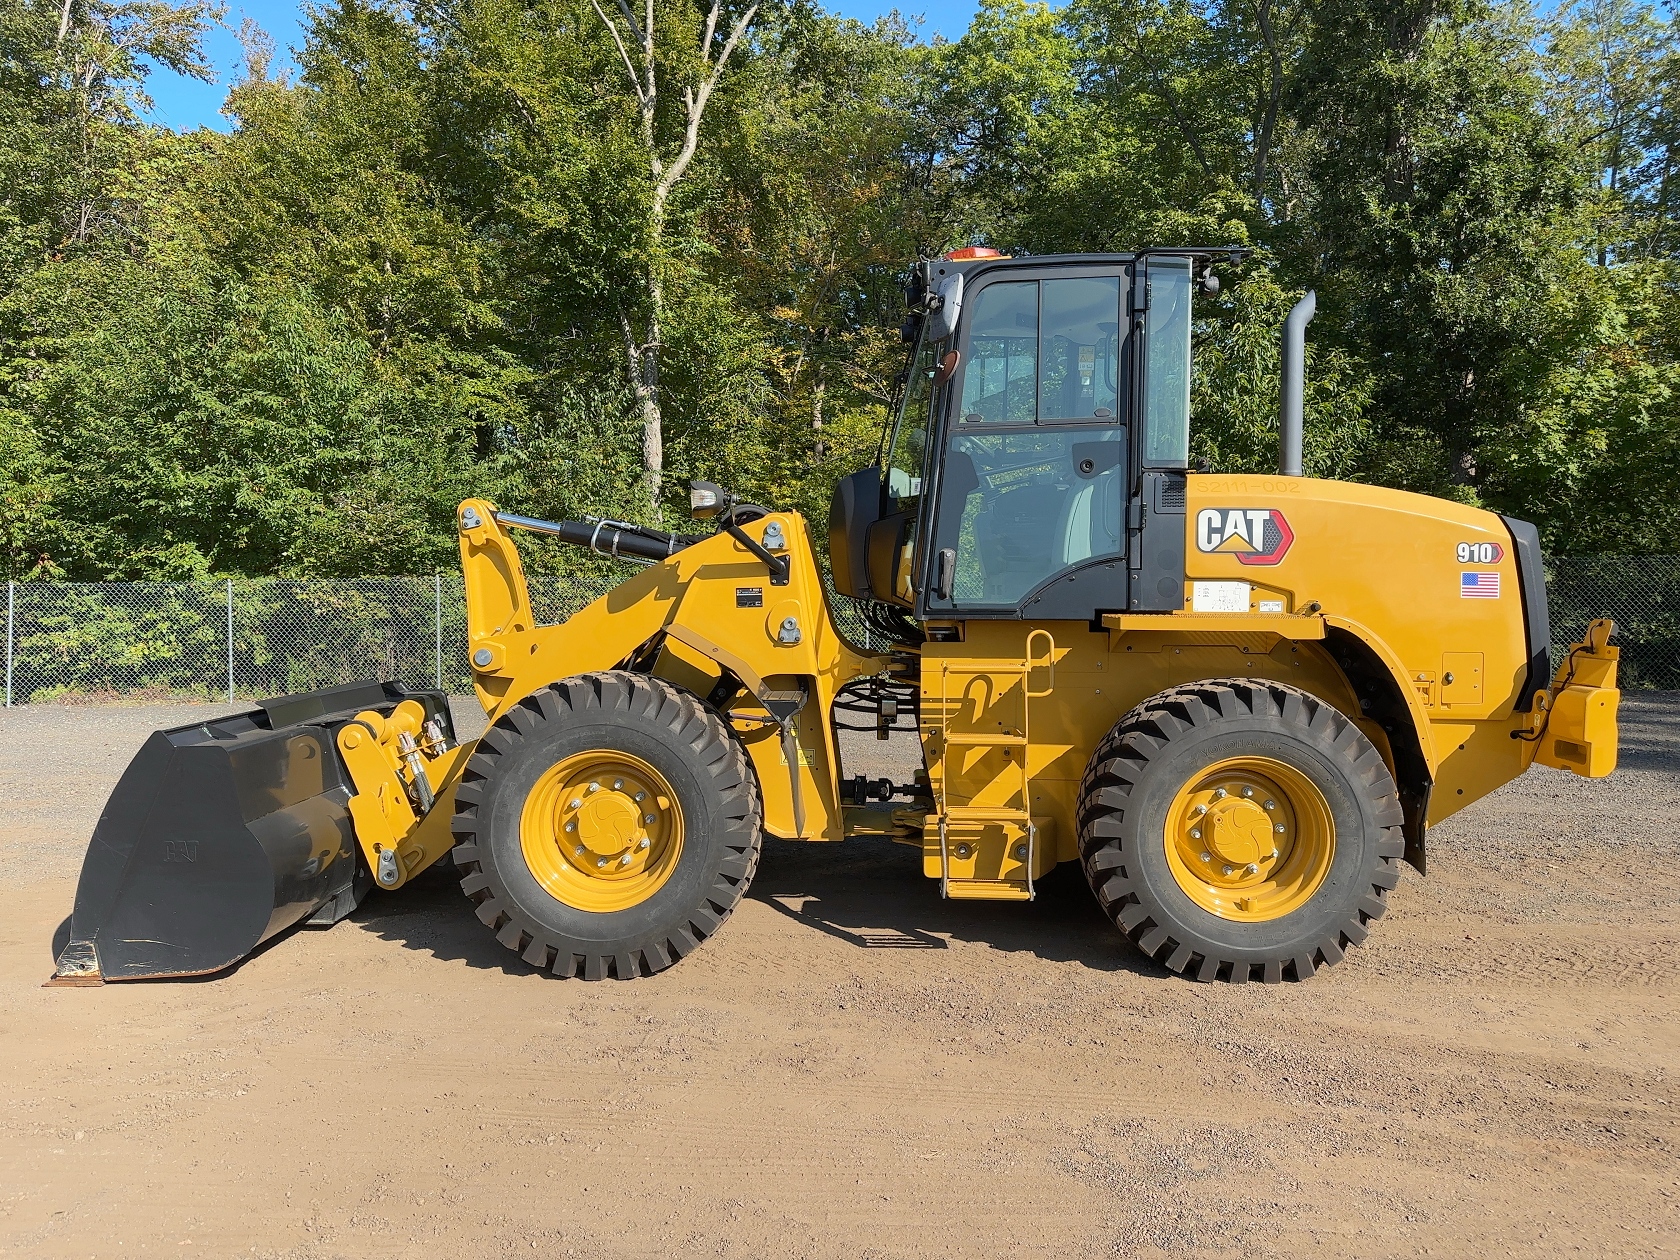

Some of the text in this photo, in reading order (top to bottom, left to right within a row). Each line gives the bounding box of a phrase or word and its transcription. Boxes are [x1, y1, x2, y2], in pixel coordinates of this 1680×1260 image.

[1196, 481, 1300, 493] S2111-002
[1197, 509, 1270, 552] CAT
[1457, 542, 1493, 563] 910
[161, 840, 200, 863] CAT
